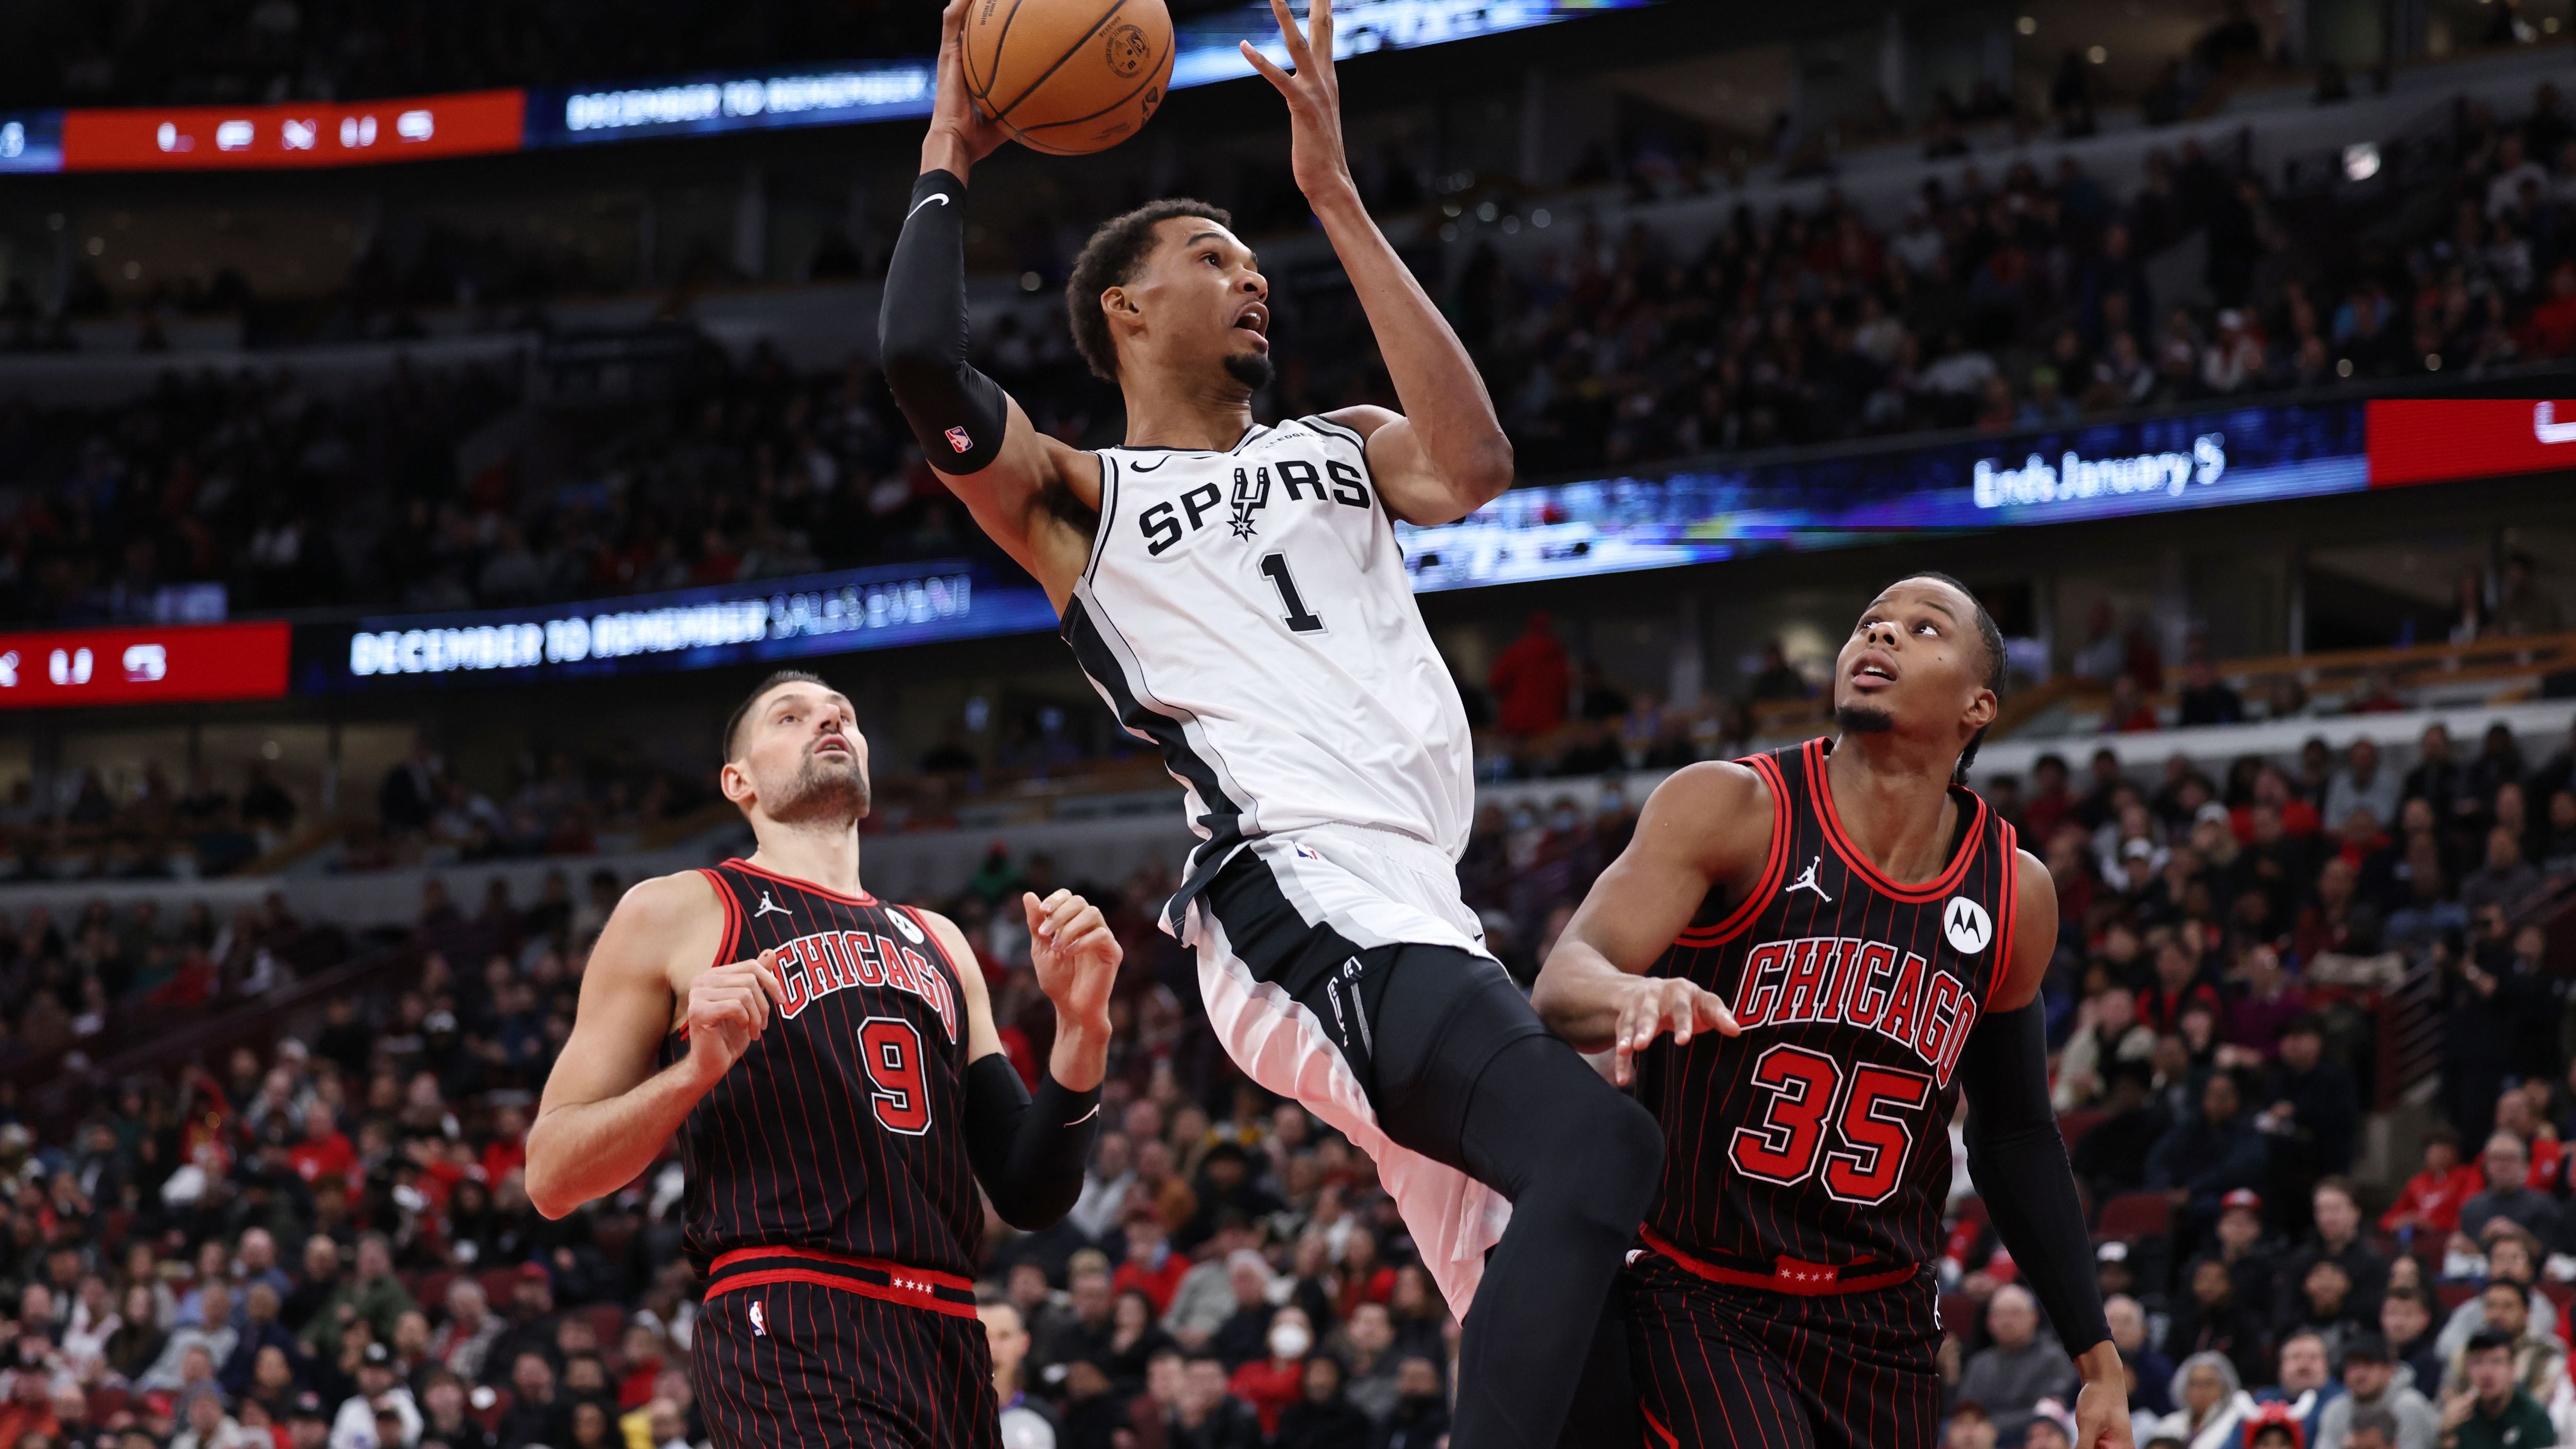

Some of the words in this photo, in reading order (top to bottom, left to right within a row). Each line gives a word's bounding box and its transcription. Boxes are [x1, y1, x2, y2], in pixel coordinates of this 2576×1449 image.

[1139, 460, 1371, 556] SPURS
[546, 617, 590, 664] TO
[1256, 548, 1329, 636] 1
[773, 930, 956, 1045] CHICAGO
[1733, 936, 1977, 1091] CHICAGO
[857, 1016, 932, 1136] 9
[1728, 1042, 1934, 1207] 35
